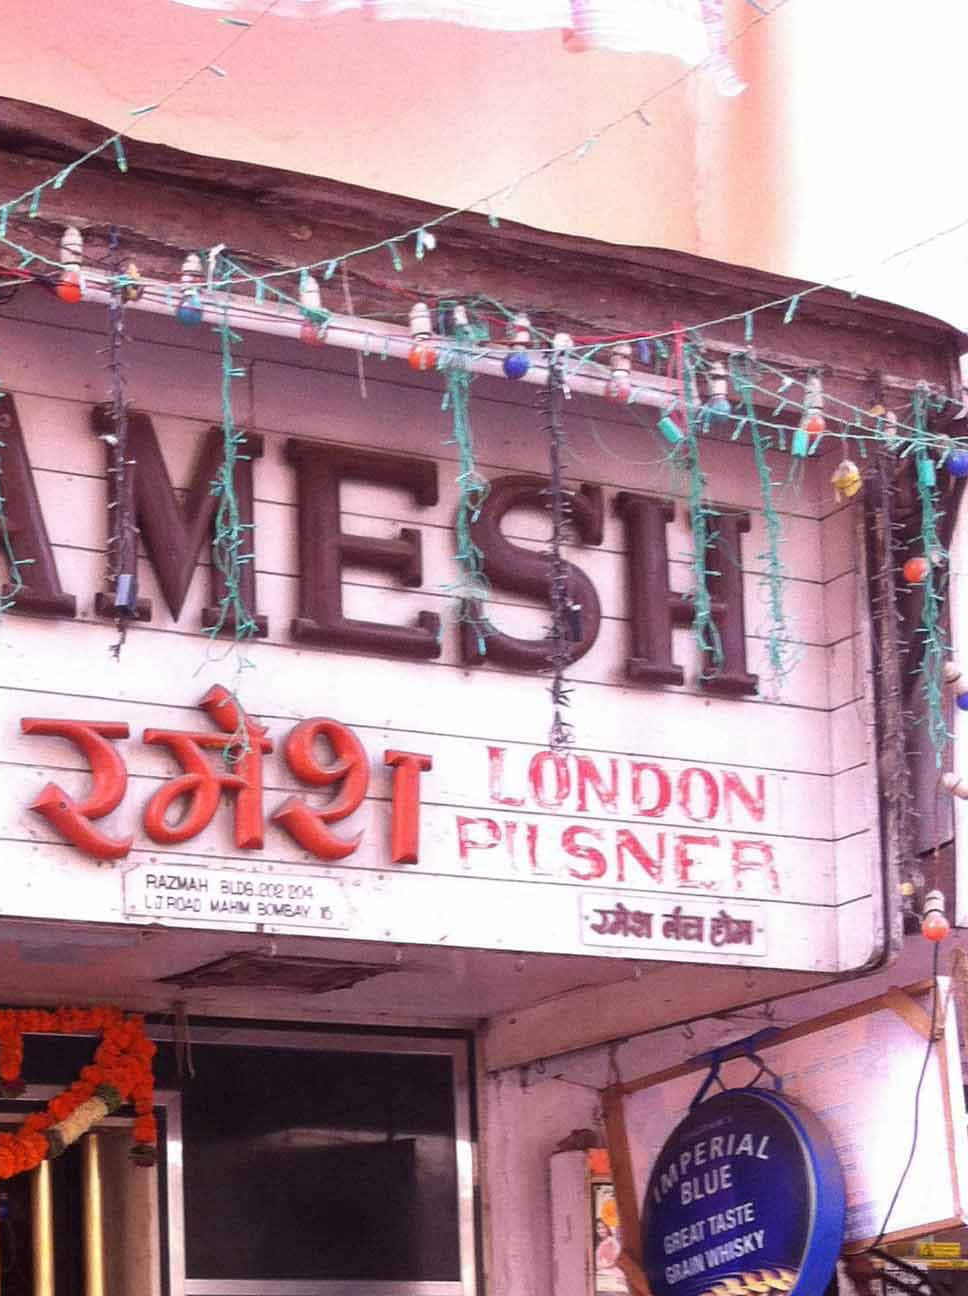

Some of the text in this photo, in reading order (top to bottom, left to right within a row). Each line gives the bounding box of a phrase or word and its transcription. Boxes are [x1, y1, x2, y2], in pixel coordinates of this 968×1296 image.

[20, 684, 432, 864] रमेश
[486, 746, 766, 822] LONDON
[455, 815, 780, 893] PILSNER
[590, 902, 654, 939] रमेश
[653, 1133, 771, 1204] IMPERIAL
[680, 1164, 733, 1206] BLUE
[663, 1201, 756, 1255] GREAT TASTE
[704, 1229, 766, 1270] WHISKY
